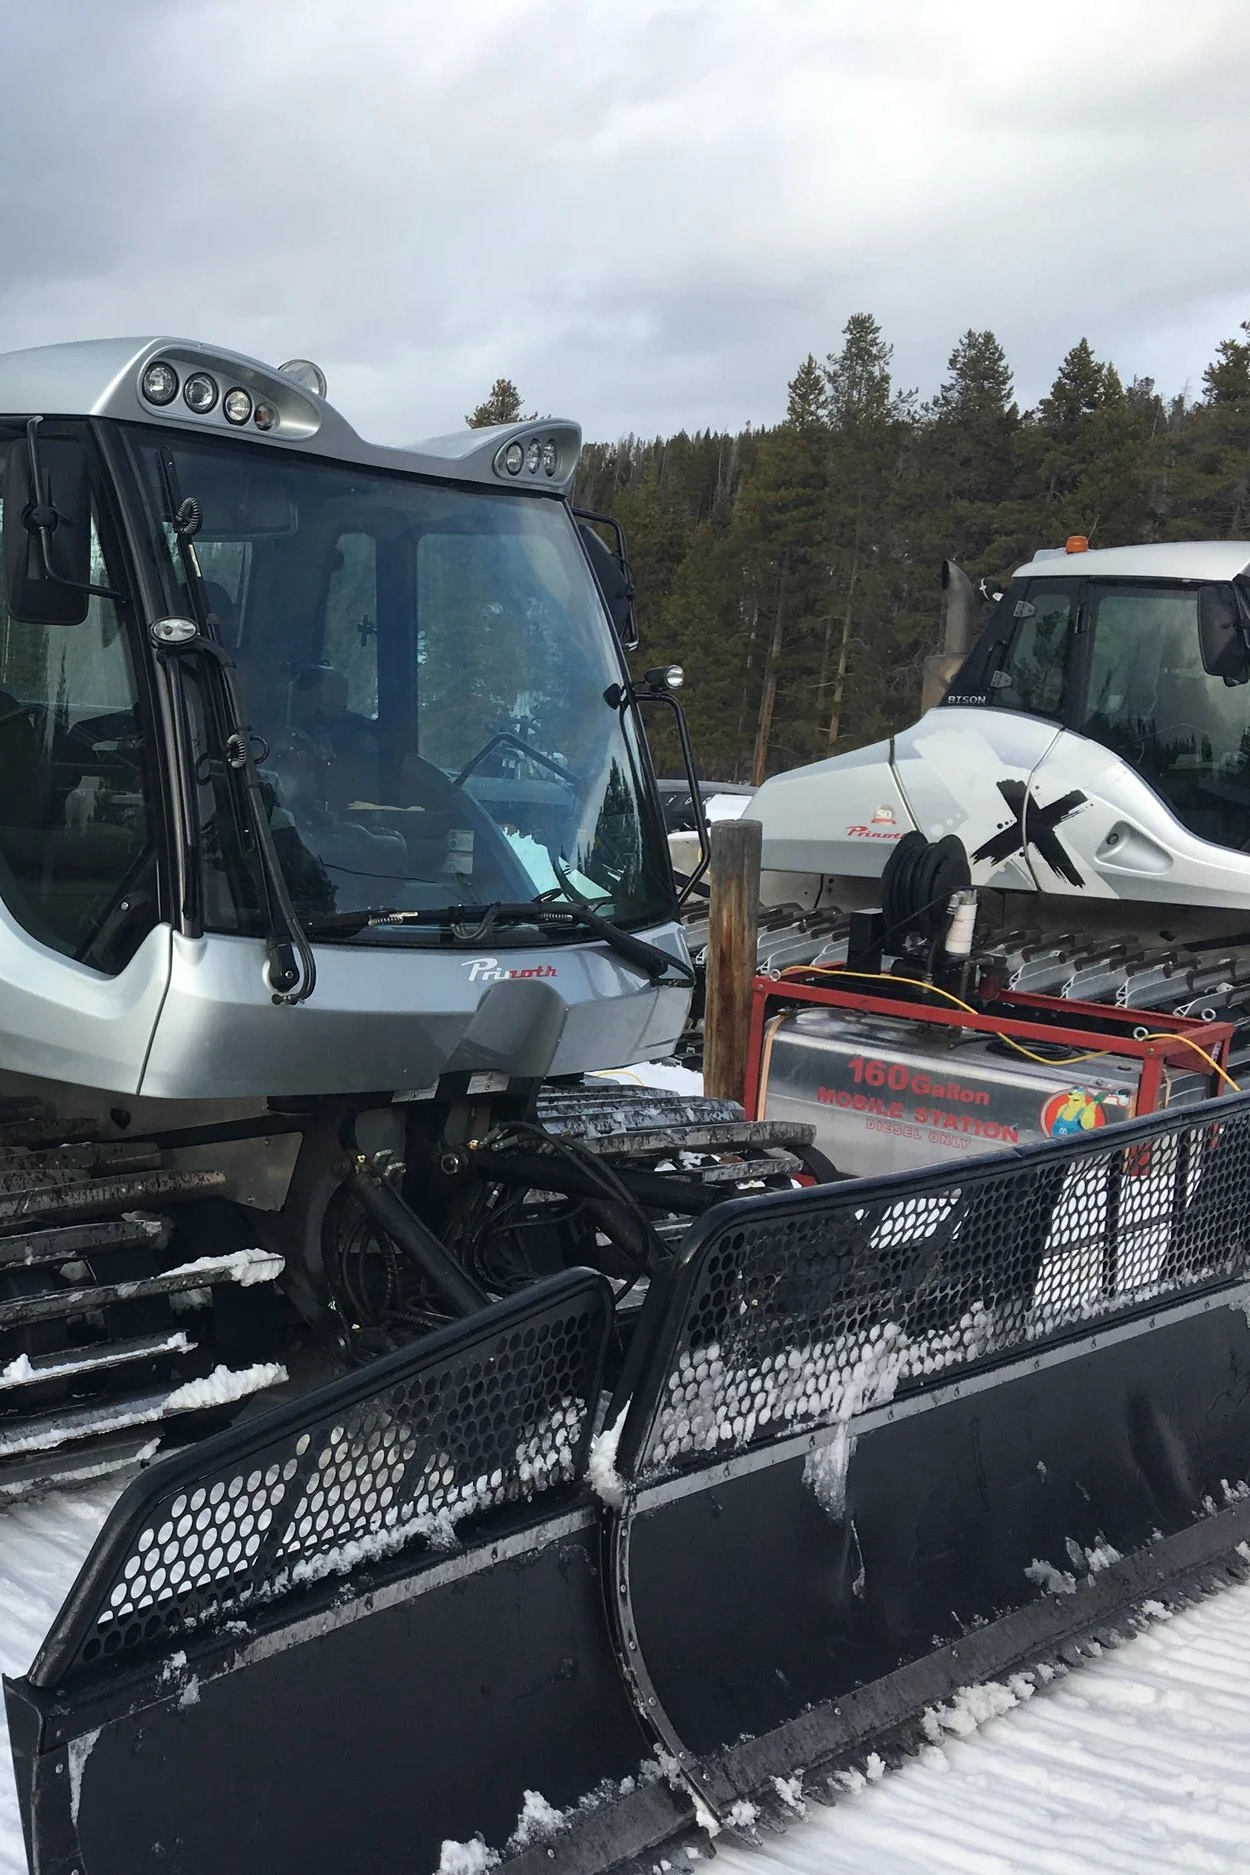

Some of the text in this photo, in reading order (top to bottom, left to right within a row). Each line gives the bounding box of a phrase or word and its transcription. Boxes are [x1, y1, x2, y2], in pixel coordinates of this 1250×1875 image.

[948, 695, 987, 704] BISON
[461, 958, 558, 981] Prinoth
[849, 1055, 990, 1105] 160 Gallon
[816, 1086, 1020, 1144] MOBILE STATION
[866, 1118, 971, 1150] DIESEL ONLY
